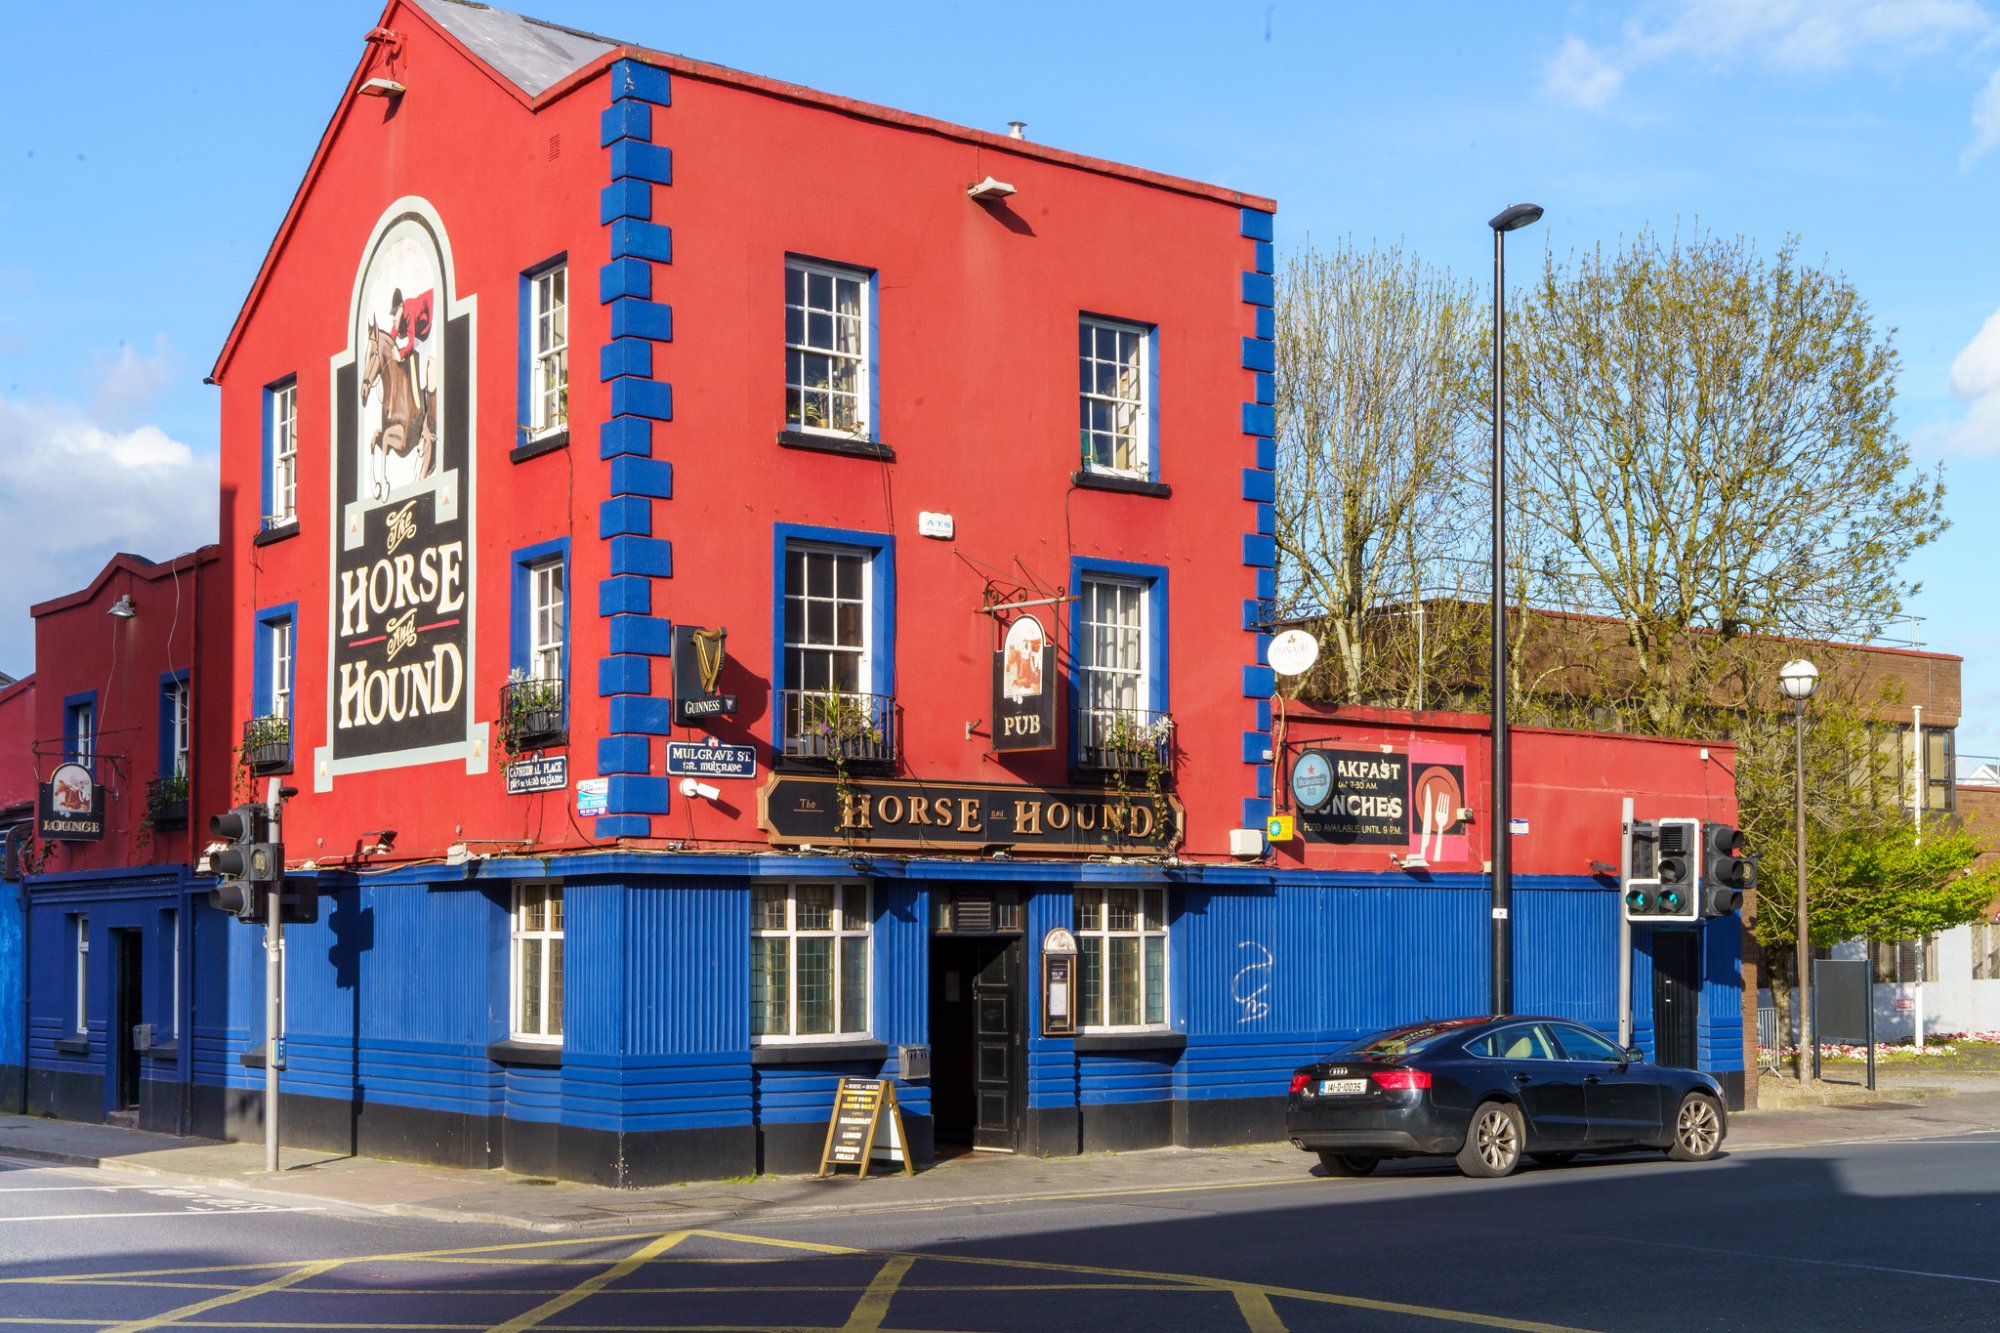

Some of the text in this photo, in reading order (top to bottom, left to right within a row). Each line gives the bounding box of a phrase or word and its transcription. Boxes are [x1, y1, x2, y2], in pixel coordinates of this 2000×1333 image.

[387, 500, 417, 554] The
[340, 541, 464, 637] HORSE
[387, 608, 417, 662] And
[339, 643, 463, 728] HOUND
[685, 699, 720, 715] GUINNESS
[1004, 714, 1041, 736] PUB
[672, 748, 751, 762] MULGRAVE ST.
[543, 761, 563, 774] PLACE
[1338, 760, 1400, 780] AKFAST
[799, 798, 816, 809] The
[841, 794, 982, 833] HORSE
[1012, 800, 1154, 838] HOUND
[1303, 794, 1402, 819] NCHES
[43, 820, 100, 832] LOUNGE
[1304, 822, 1321, 832] FOOD
[1324, 823, 1360, 833] AVAILABLE
[1361, 825, 1381, 834] UNTIL
[1383, 825, 1388, 834] 9
[1327, 1082, 1362, 1092] 141-D-10035
